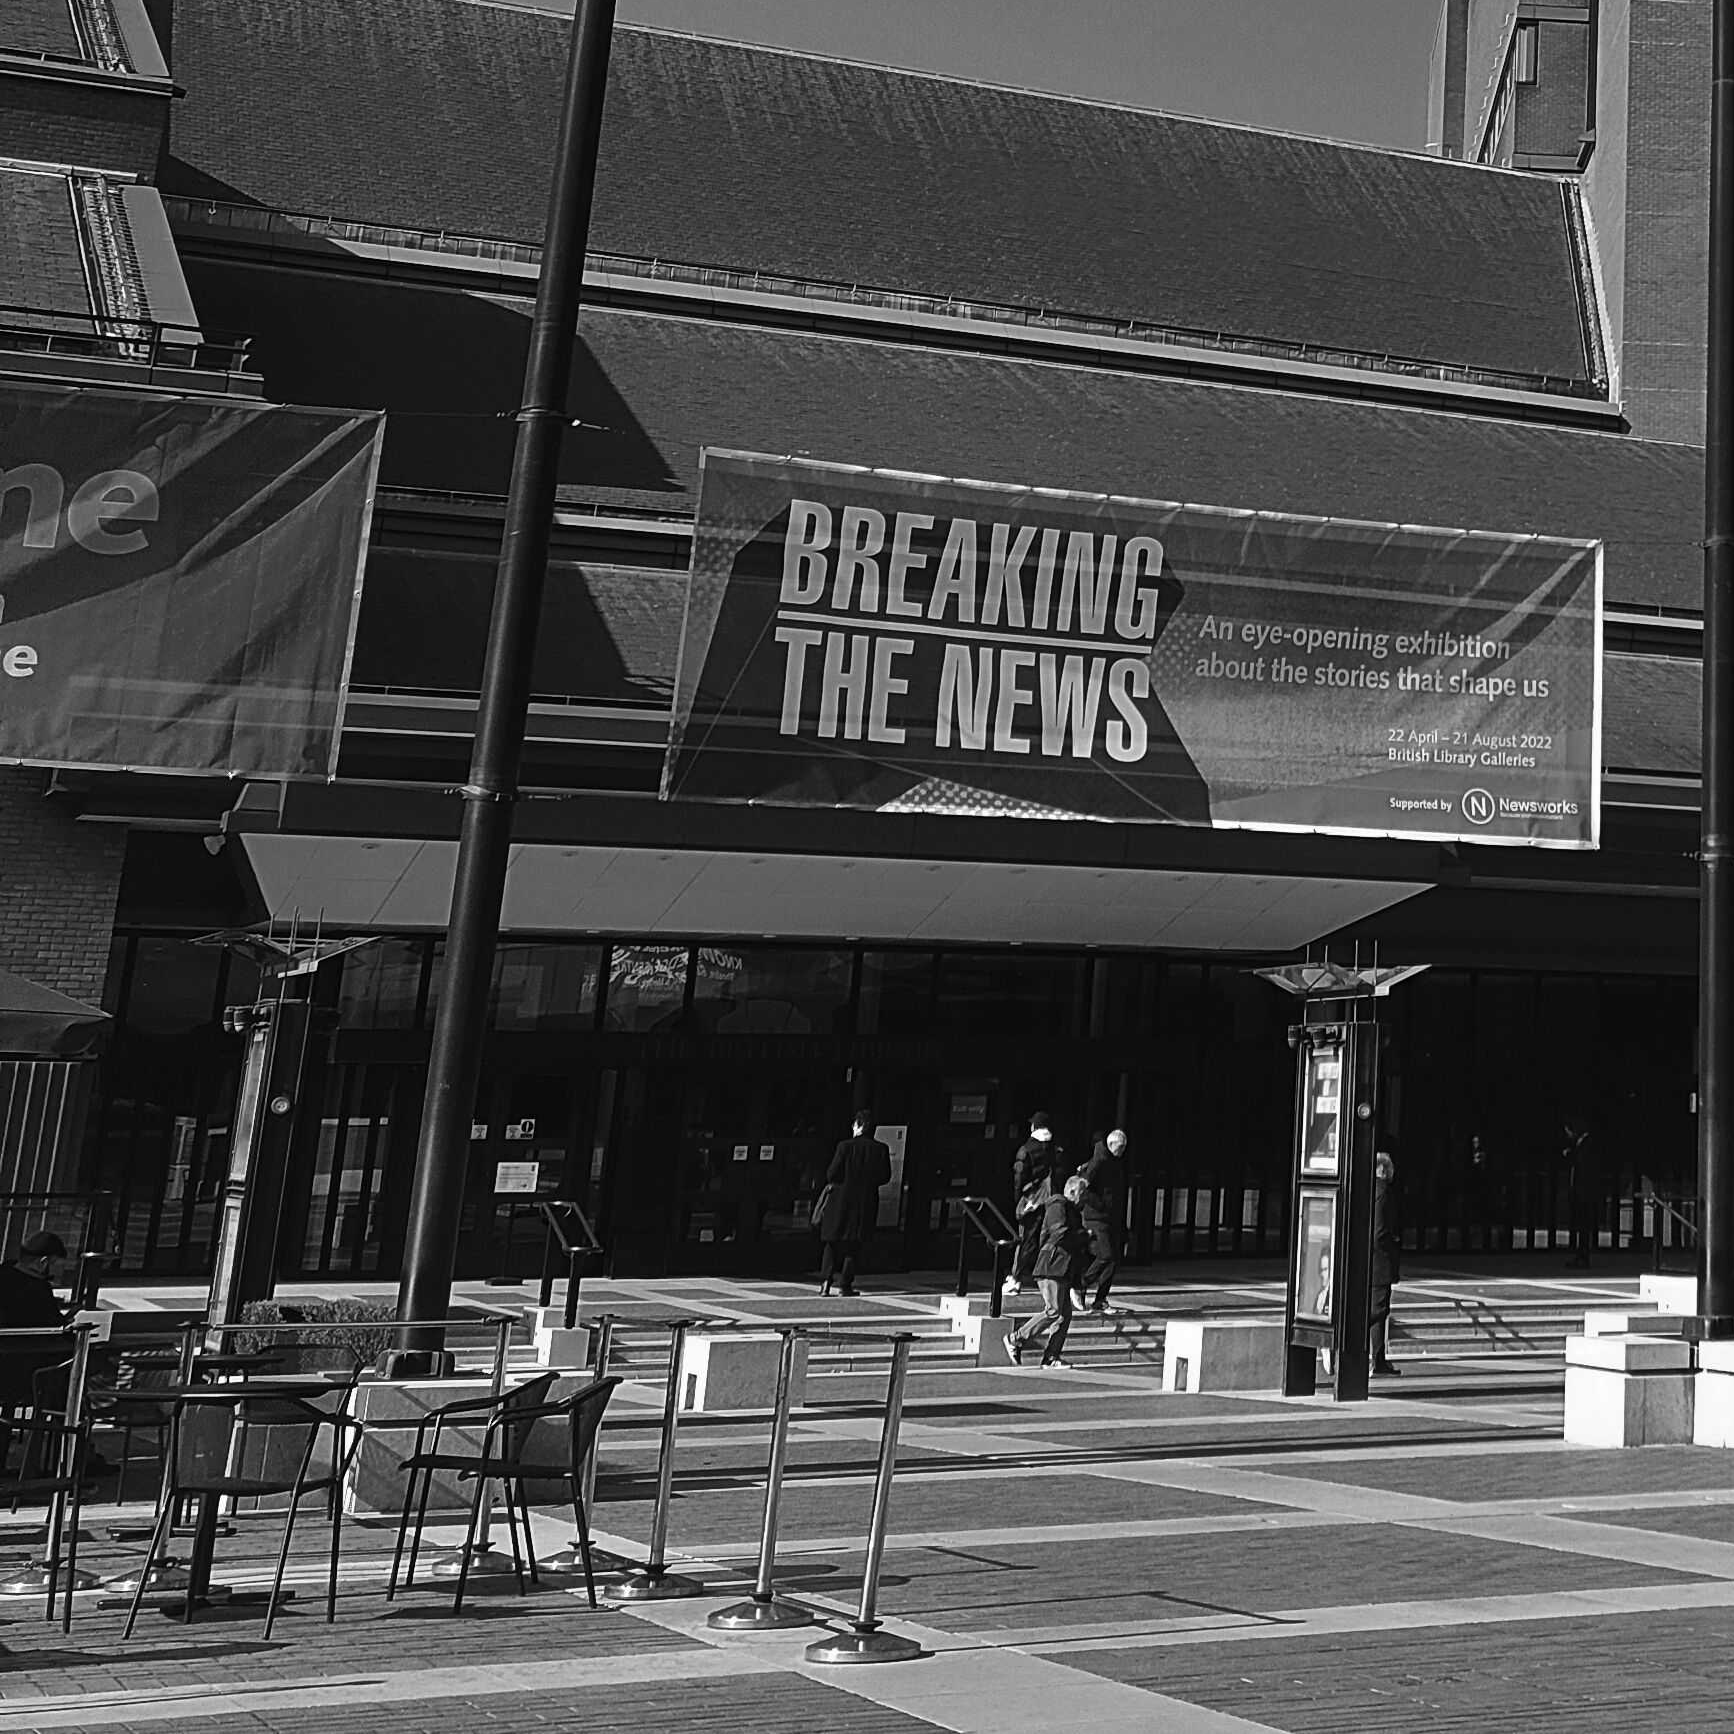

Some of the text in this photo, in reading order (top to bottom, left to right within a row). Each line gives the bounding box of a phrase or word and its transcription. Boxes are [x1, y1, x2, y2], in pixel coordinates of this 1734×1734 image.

[779, 498, 1164, 640] BREAKING
[1199, 615, 1510, 660] An eye-opening exhibition
[0, 644, 38, 678] e
[1195, 651, 1549, 702] about the stories that shape us
[774, 626, 1150, 763] THE NEWS
[1388, 729, 1404, 742] 22
[1408, 729, 1438, 747] April
[1452, 731, 1468, 745] 21
[1472, 733, 1517, 751] August
[1520, 735, 1552, 750] 2022
[1388, 747, 1536, 767] British Library Galleries
[1389, 797, 1452, 813] Supported by
[1470, 796, 1487, 817] N
[1499, 797, 1578, 815] Newsworks
